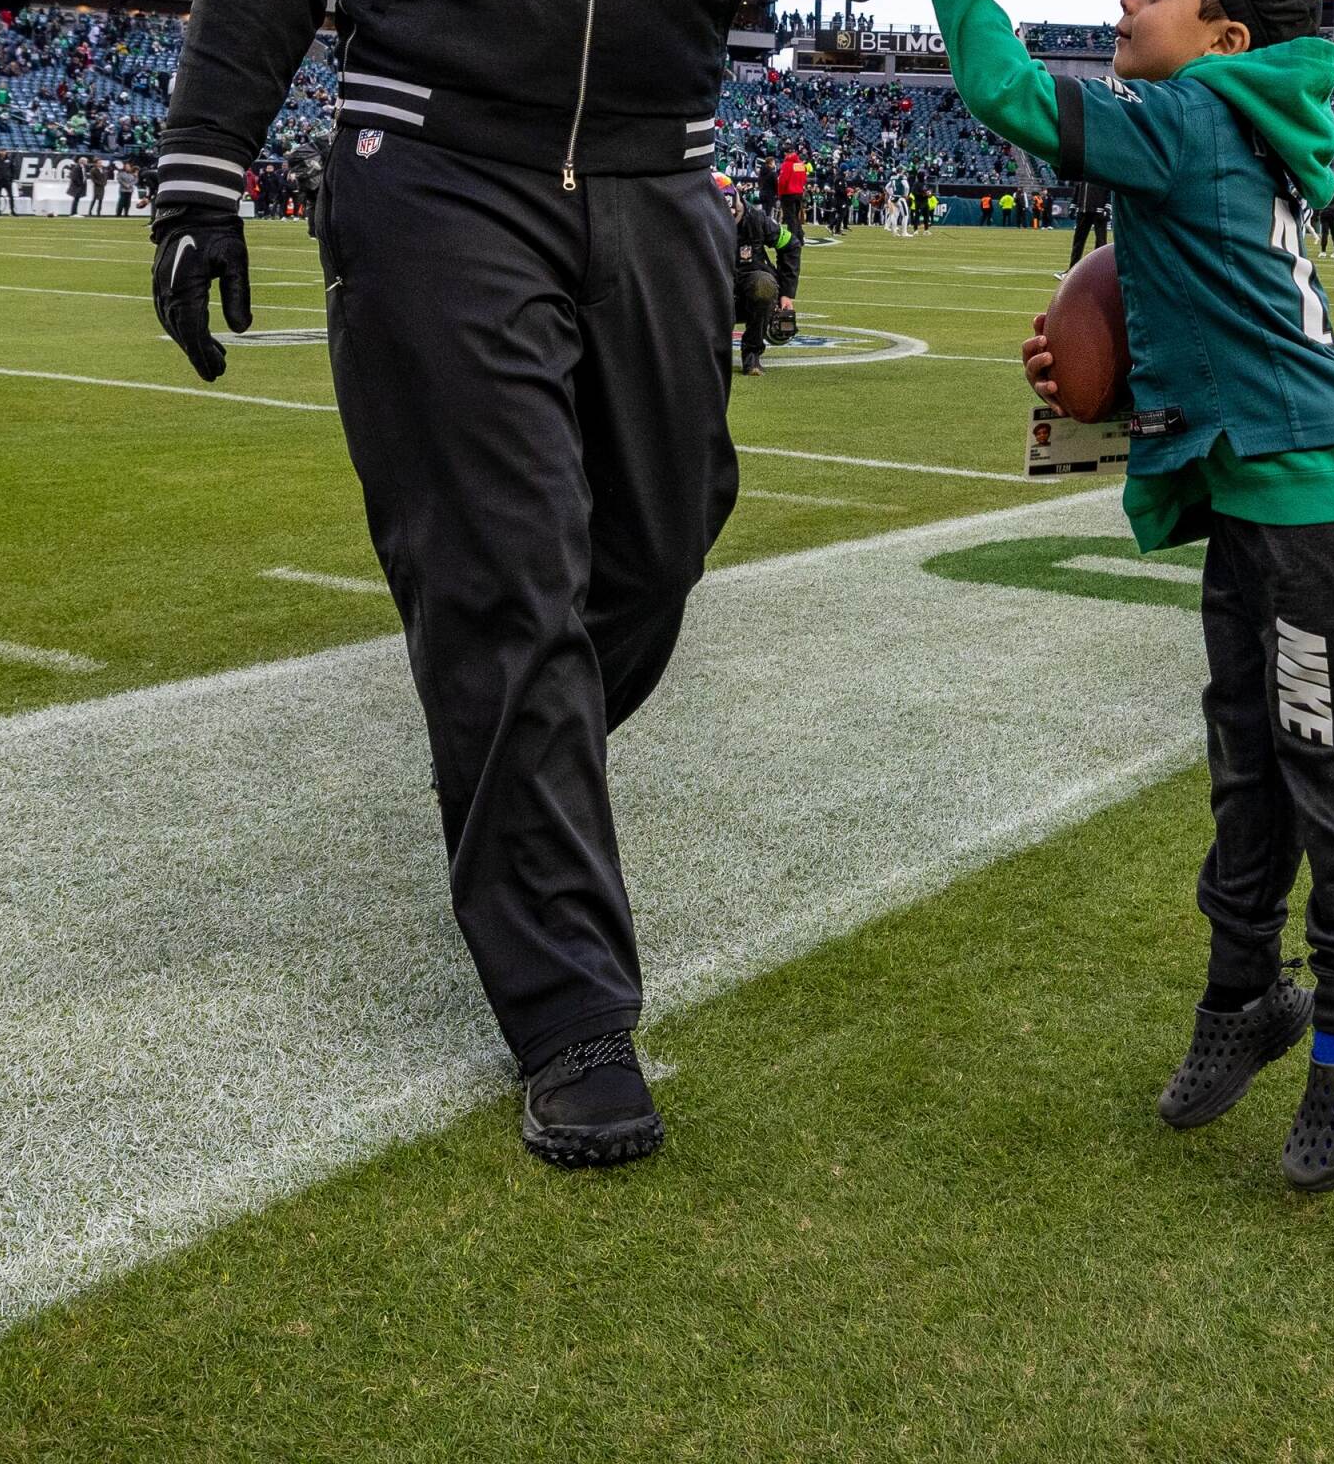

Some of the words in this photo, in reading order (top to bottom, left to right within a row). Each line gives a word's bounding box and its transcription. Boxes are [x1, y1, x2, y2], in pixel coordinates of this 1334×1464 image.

[860, 32, 945, 53] BETMG
[1055, 463, 1072, 473] TEAM
[1275, 616, 1334, 747] NIKE
